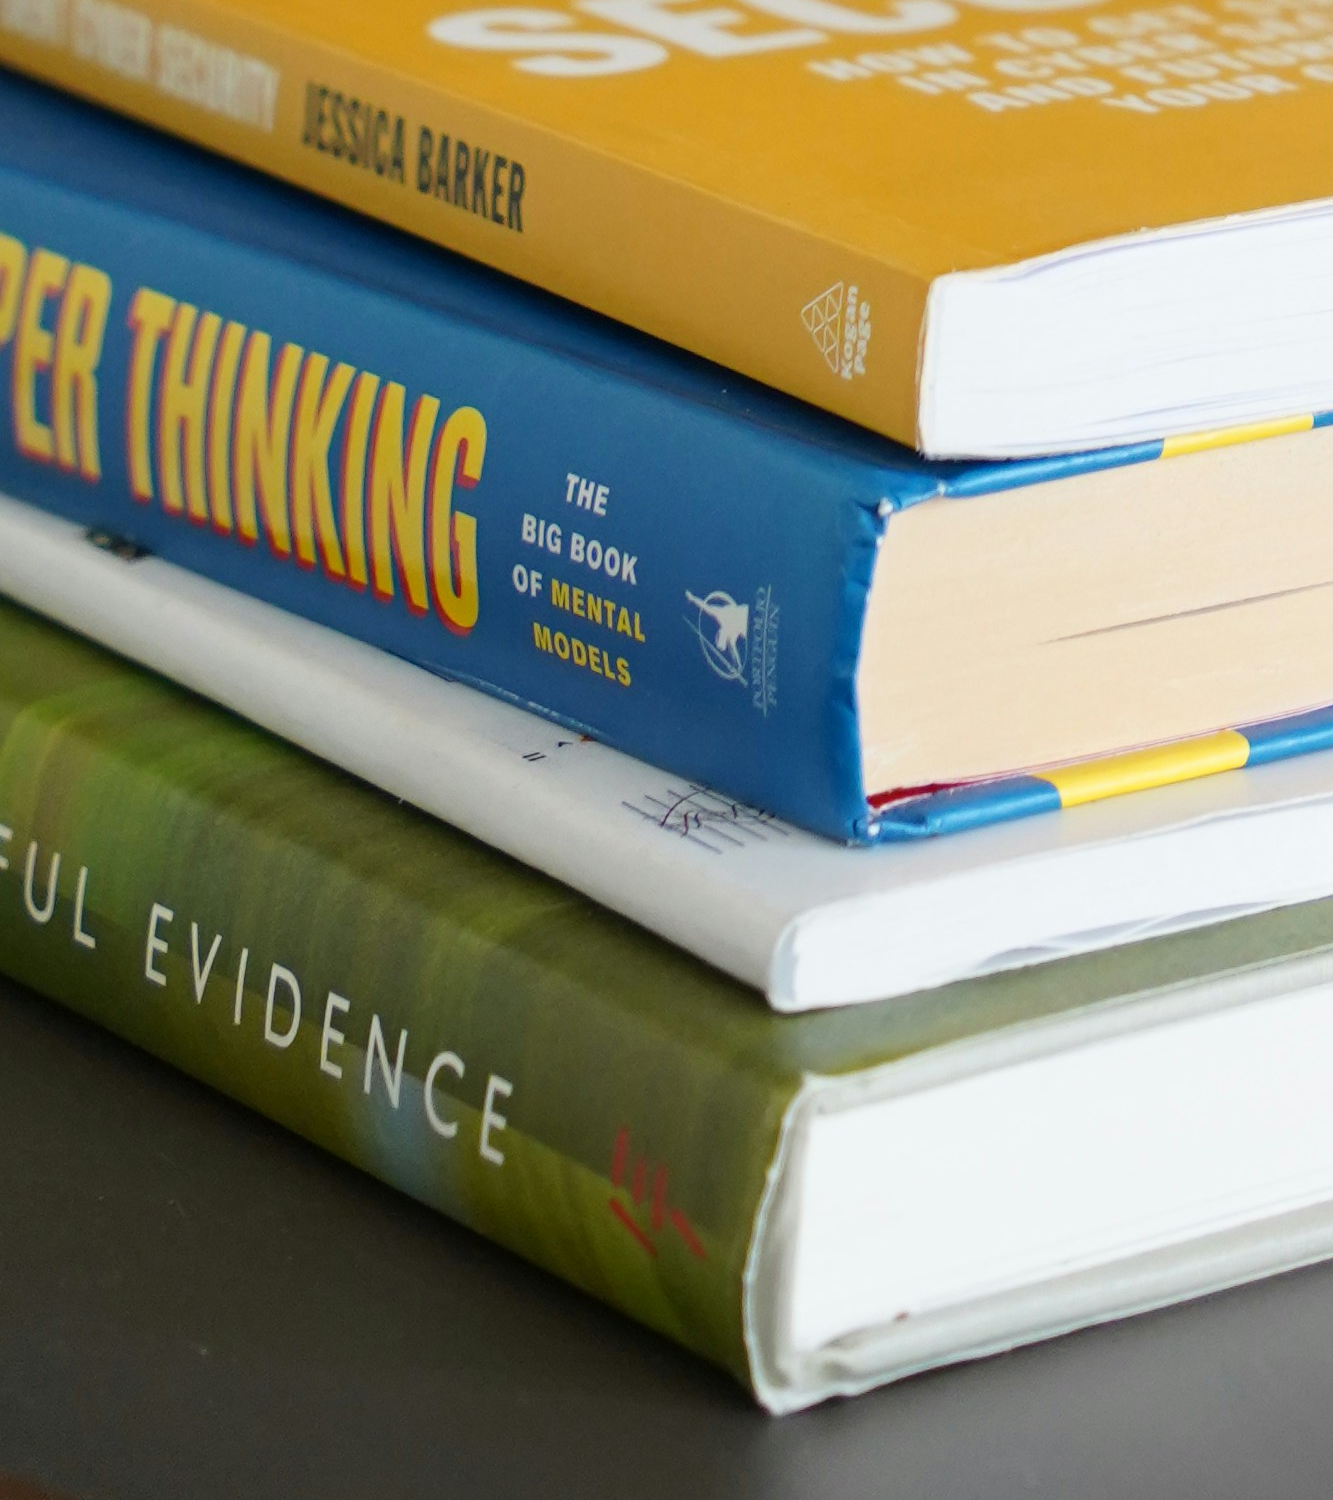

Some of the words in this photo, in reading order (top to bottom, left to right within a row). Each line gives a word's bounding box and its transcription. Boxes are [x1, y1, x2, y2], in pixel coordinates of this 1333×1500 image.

[804, 42, 975, 81] HOW
[974, 26, 1080, 55] TO
[895, 68, 990, 97] IN
[965, 76, 1114, 113] AND
[1098, 73, 1298, 114] YOUR
[301, 79, 408, 185] JESSICA
[416, 125, 525, 234] BARKER
[841, 285, 859, 380] Kogan
[854, 301, 871, 375] Page
[127, 286, 487, 637] THINKING
[566, 472, 610, 516] THE
[521, 512, 562, 555] BIG
[569, 531, 638, 586] BOOK
[512, 563, 543, 597] OF
[551, 578, 646, 643] MENTAL
[533, 621, 632, 687] MODELS
[145, 902, 513, 1167] EVIDENCE
